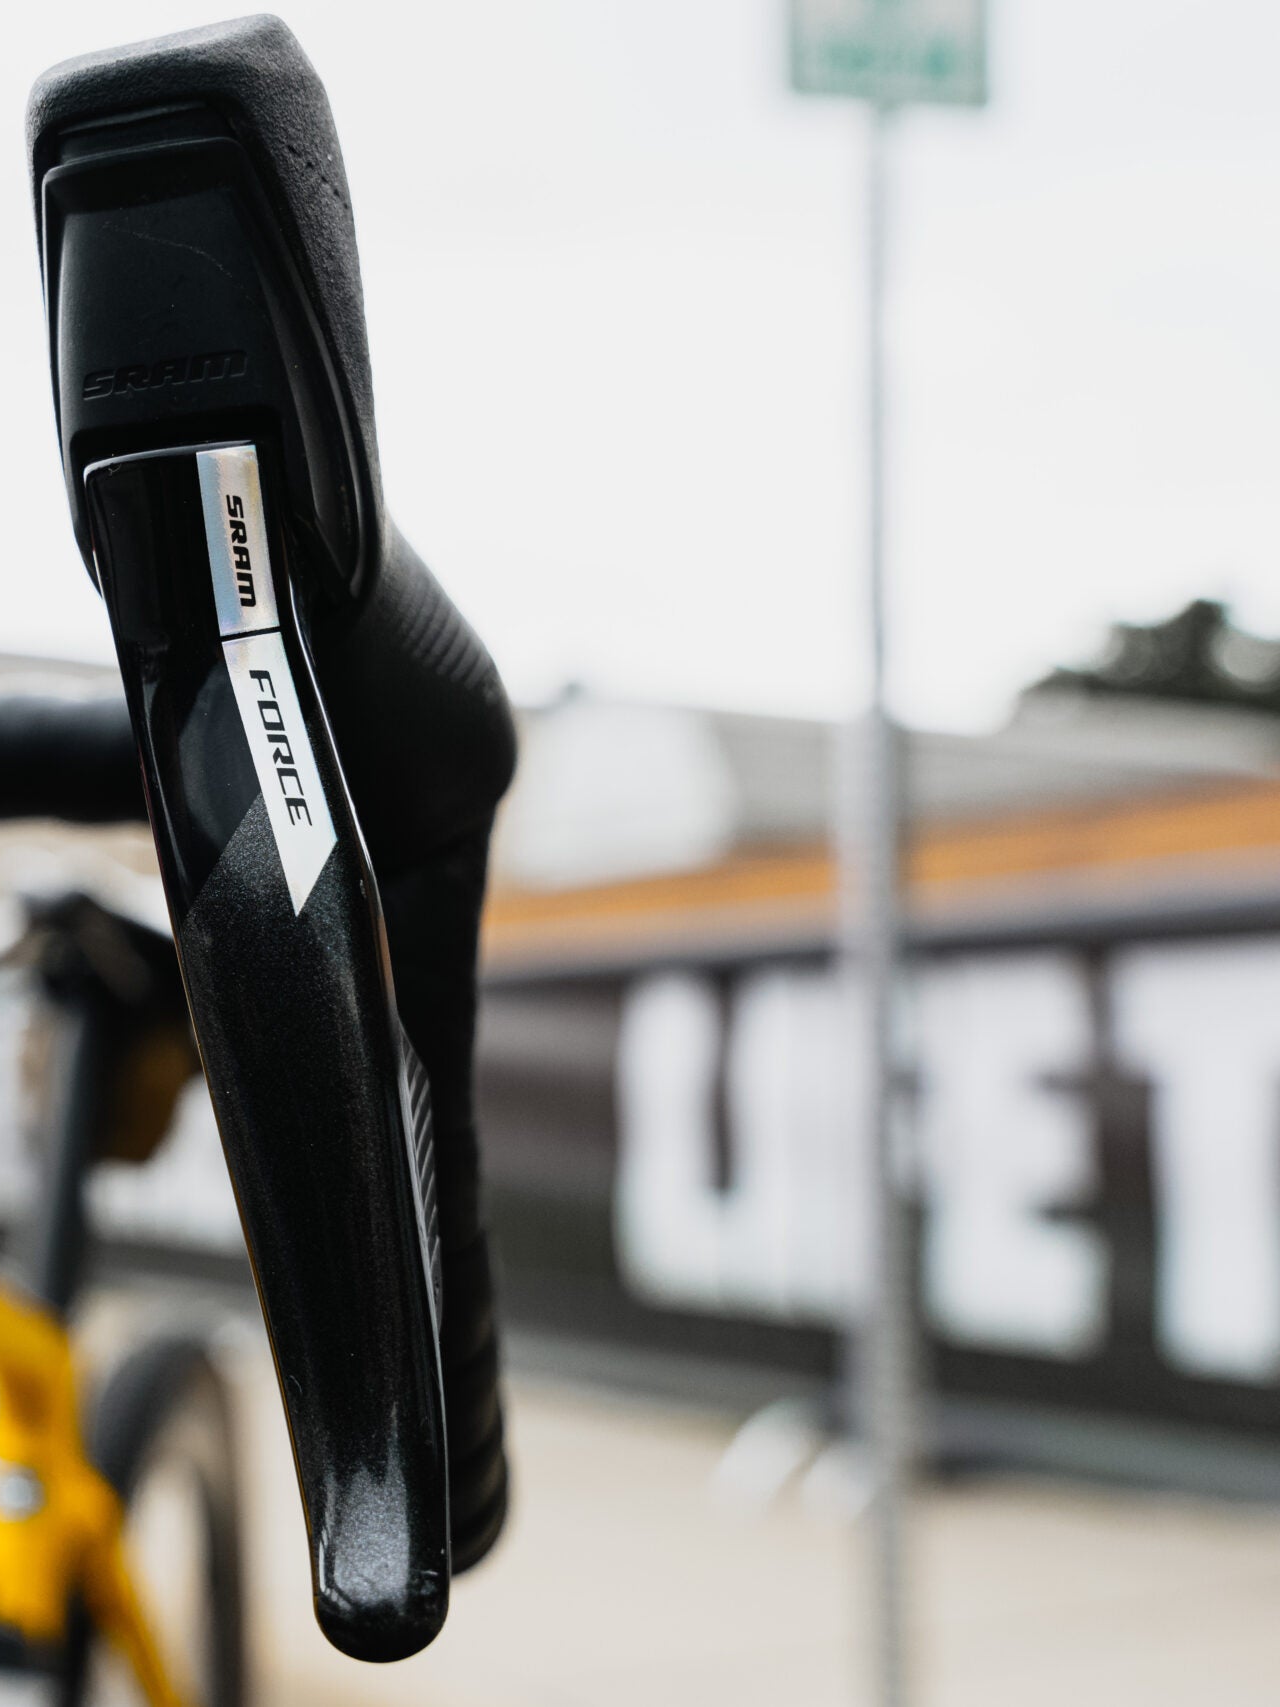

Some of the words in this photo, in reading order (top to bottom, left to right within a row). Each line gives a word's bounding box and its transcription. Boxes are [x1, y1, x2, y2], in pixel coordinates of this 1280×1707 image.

[82, 350, 248, 401] SRAM
[226, 494, 257, 608] SRAM
[249, 669, 313, 827] FORCE
